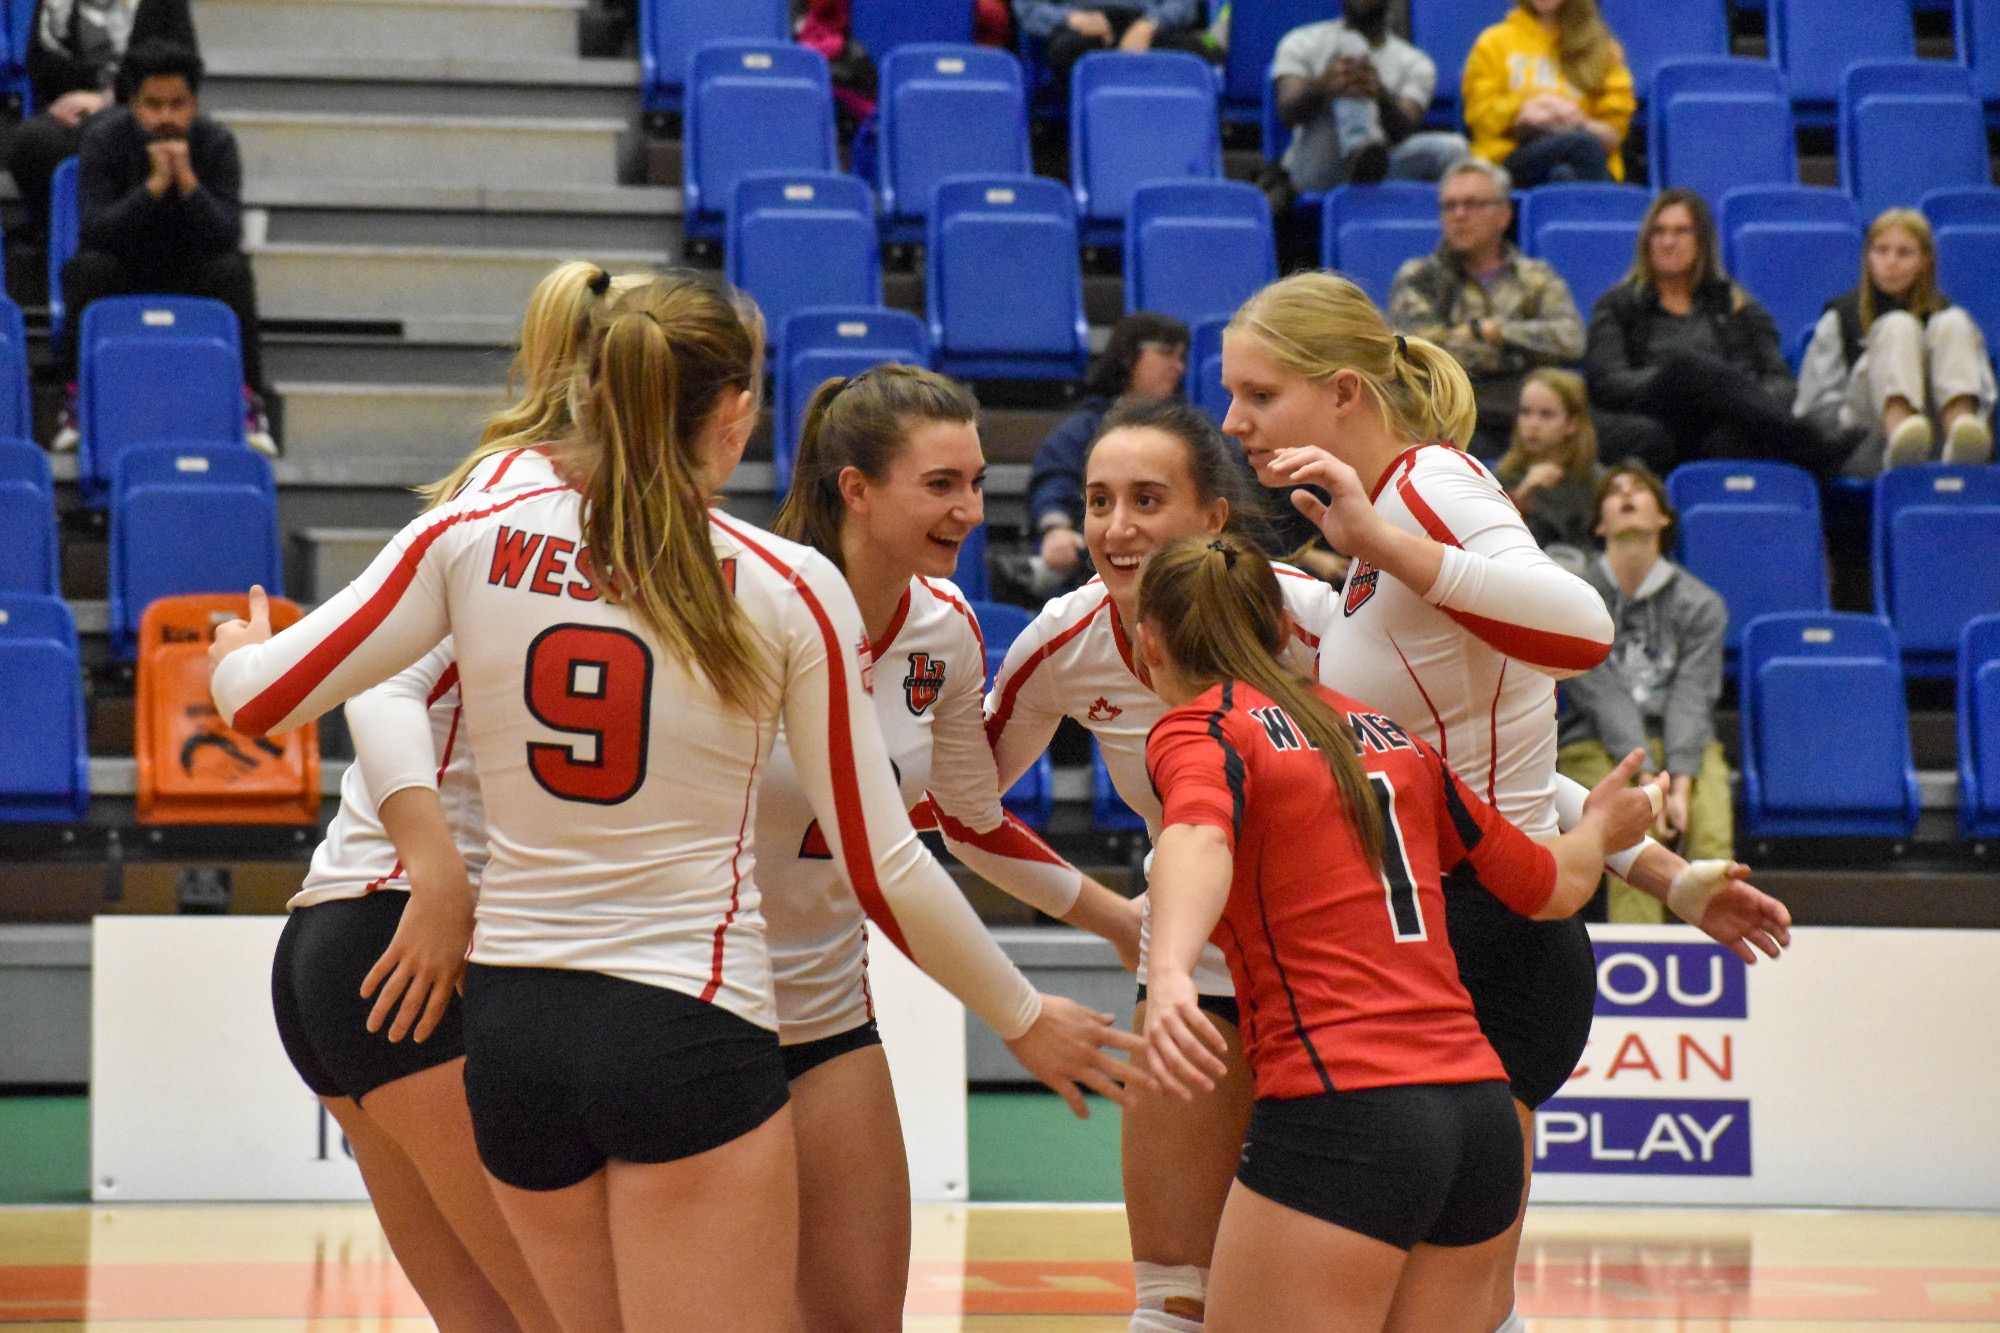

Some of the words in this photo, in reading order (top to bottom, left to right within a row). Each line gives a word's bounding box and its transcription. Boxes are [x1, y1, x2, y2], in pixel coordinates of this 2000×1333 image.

[523, 622, 654, 806] 9
[1366, 770, 1428, 943] 1
[597, 952, 723, 1007] OU
[1535, 1111, 1734, 1162] PLAY
